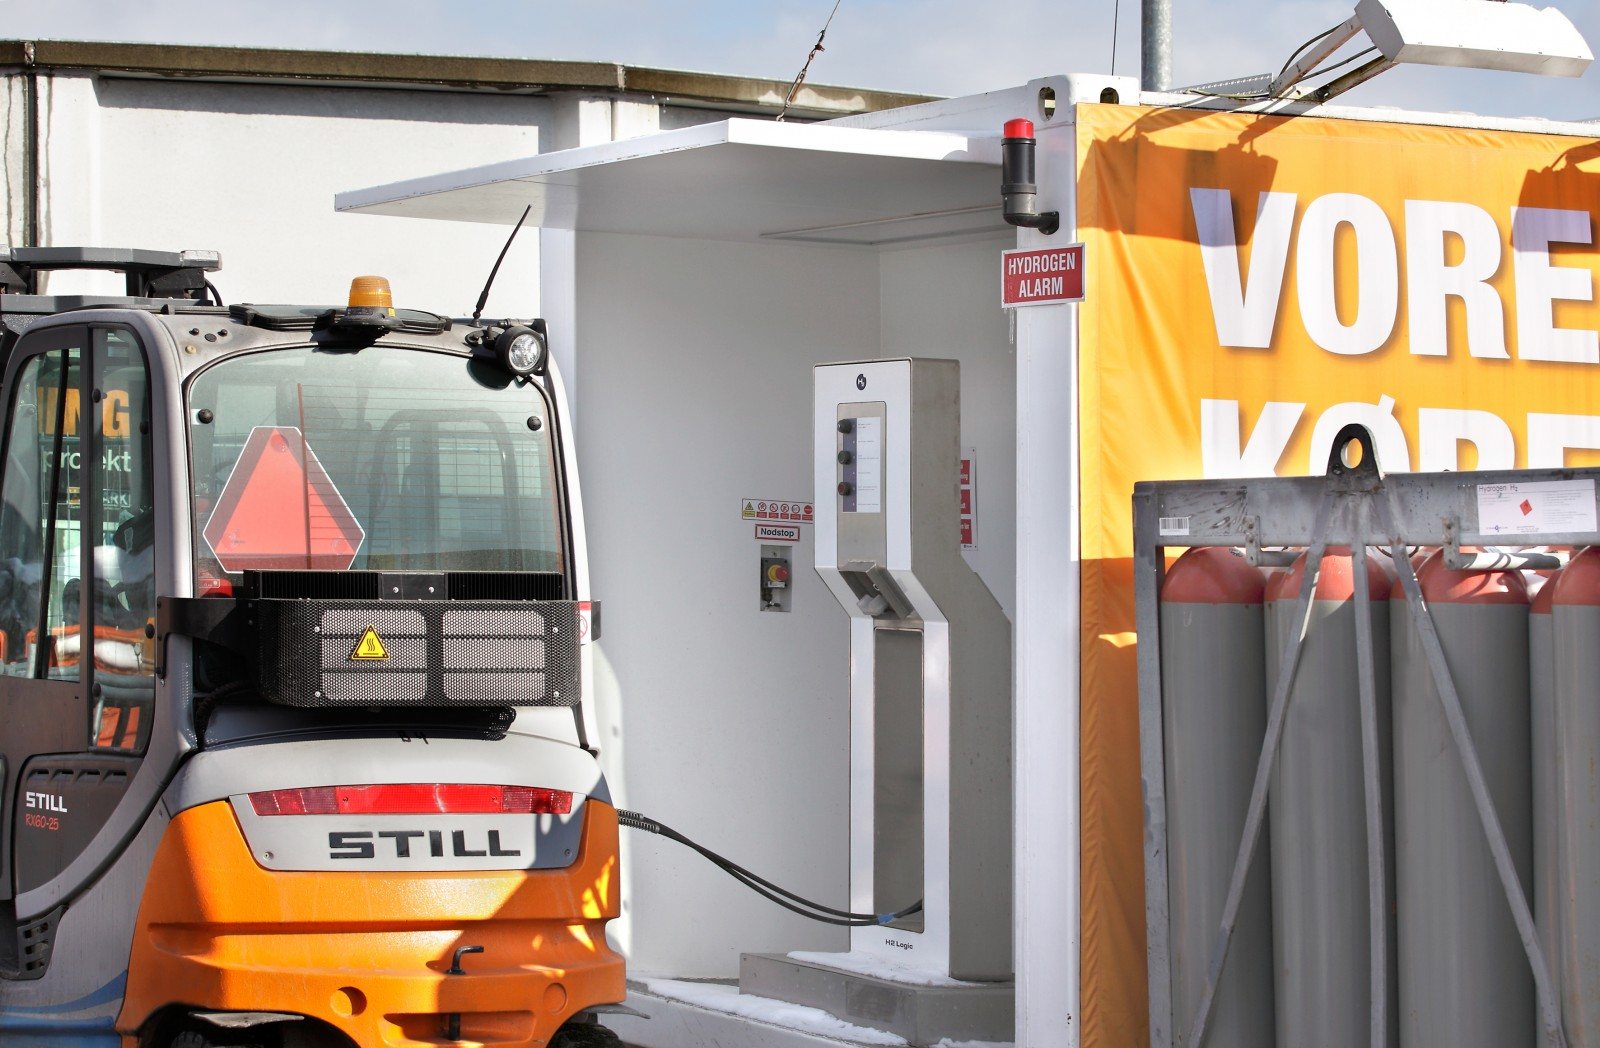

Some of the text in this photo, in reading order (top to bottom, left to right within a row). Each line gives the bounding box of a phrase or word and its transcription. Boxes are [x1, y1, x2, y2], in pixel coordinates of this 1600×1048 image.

[1008, 252, 1076, 276] HYDROGEN
[1190, 187, 1600, 364] VORE
[1018, 276, 1063, 298] ALARM
[41, 448, 131, 473] prokt
[25, 791, 68, 813] STILL
[25, 814, 59, 830] RX60-25
[328, 829, 521, 859] STILL
[885, 938, 913, 950] H2 Logic
